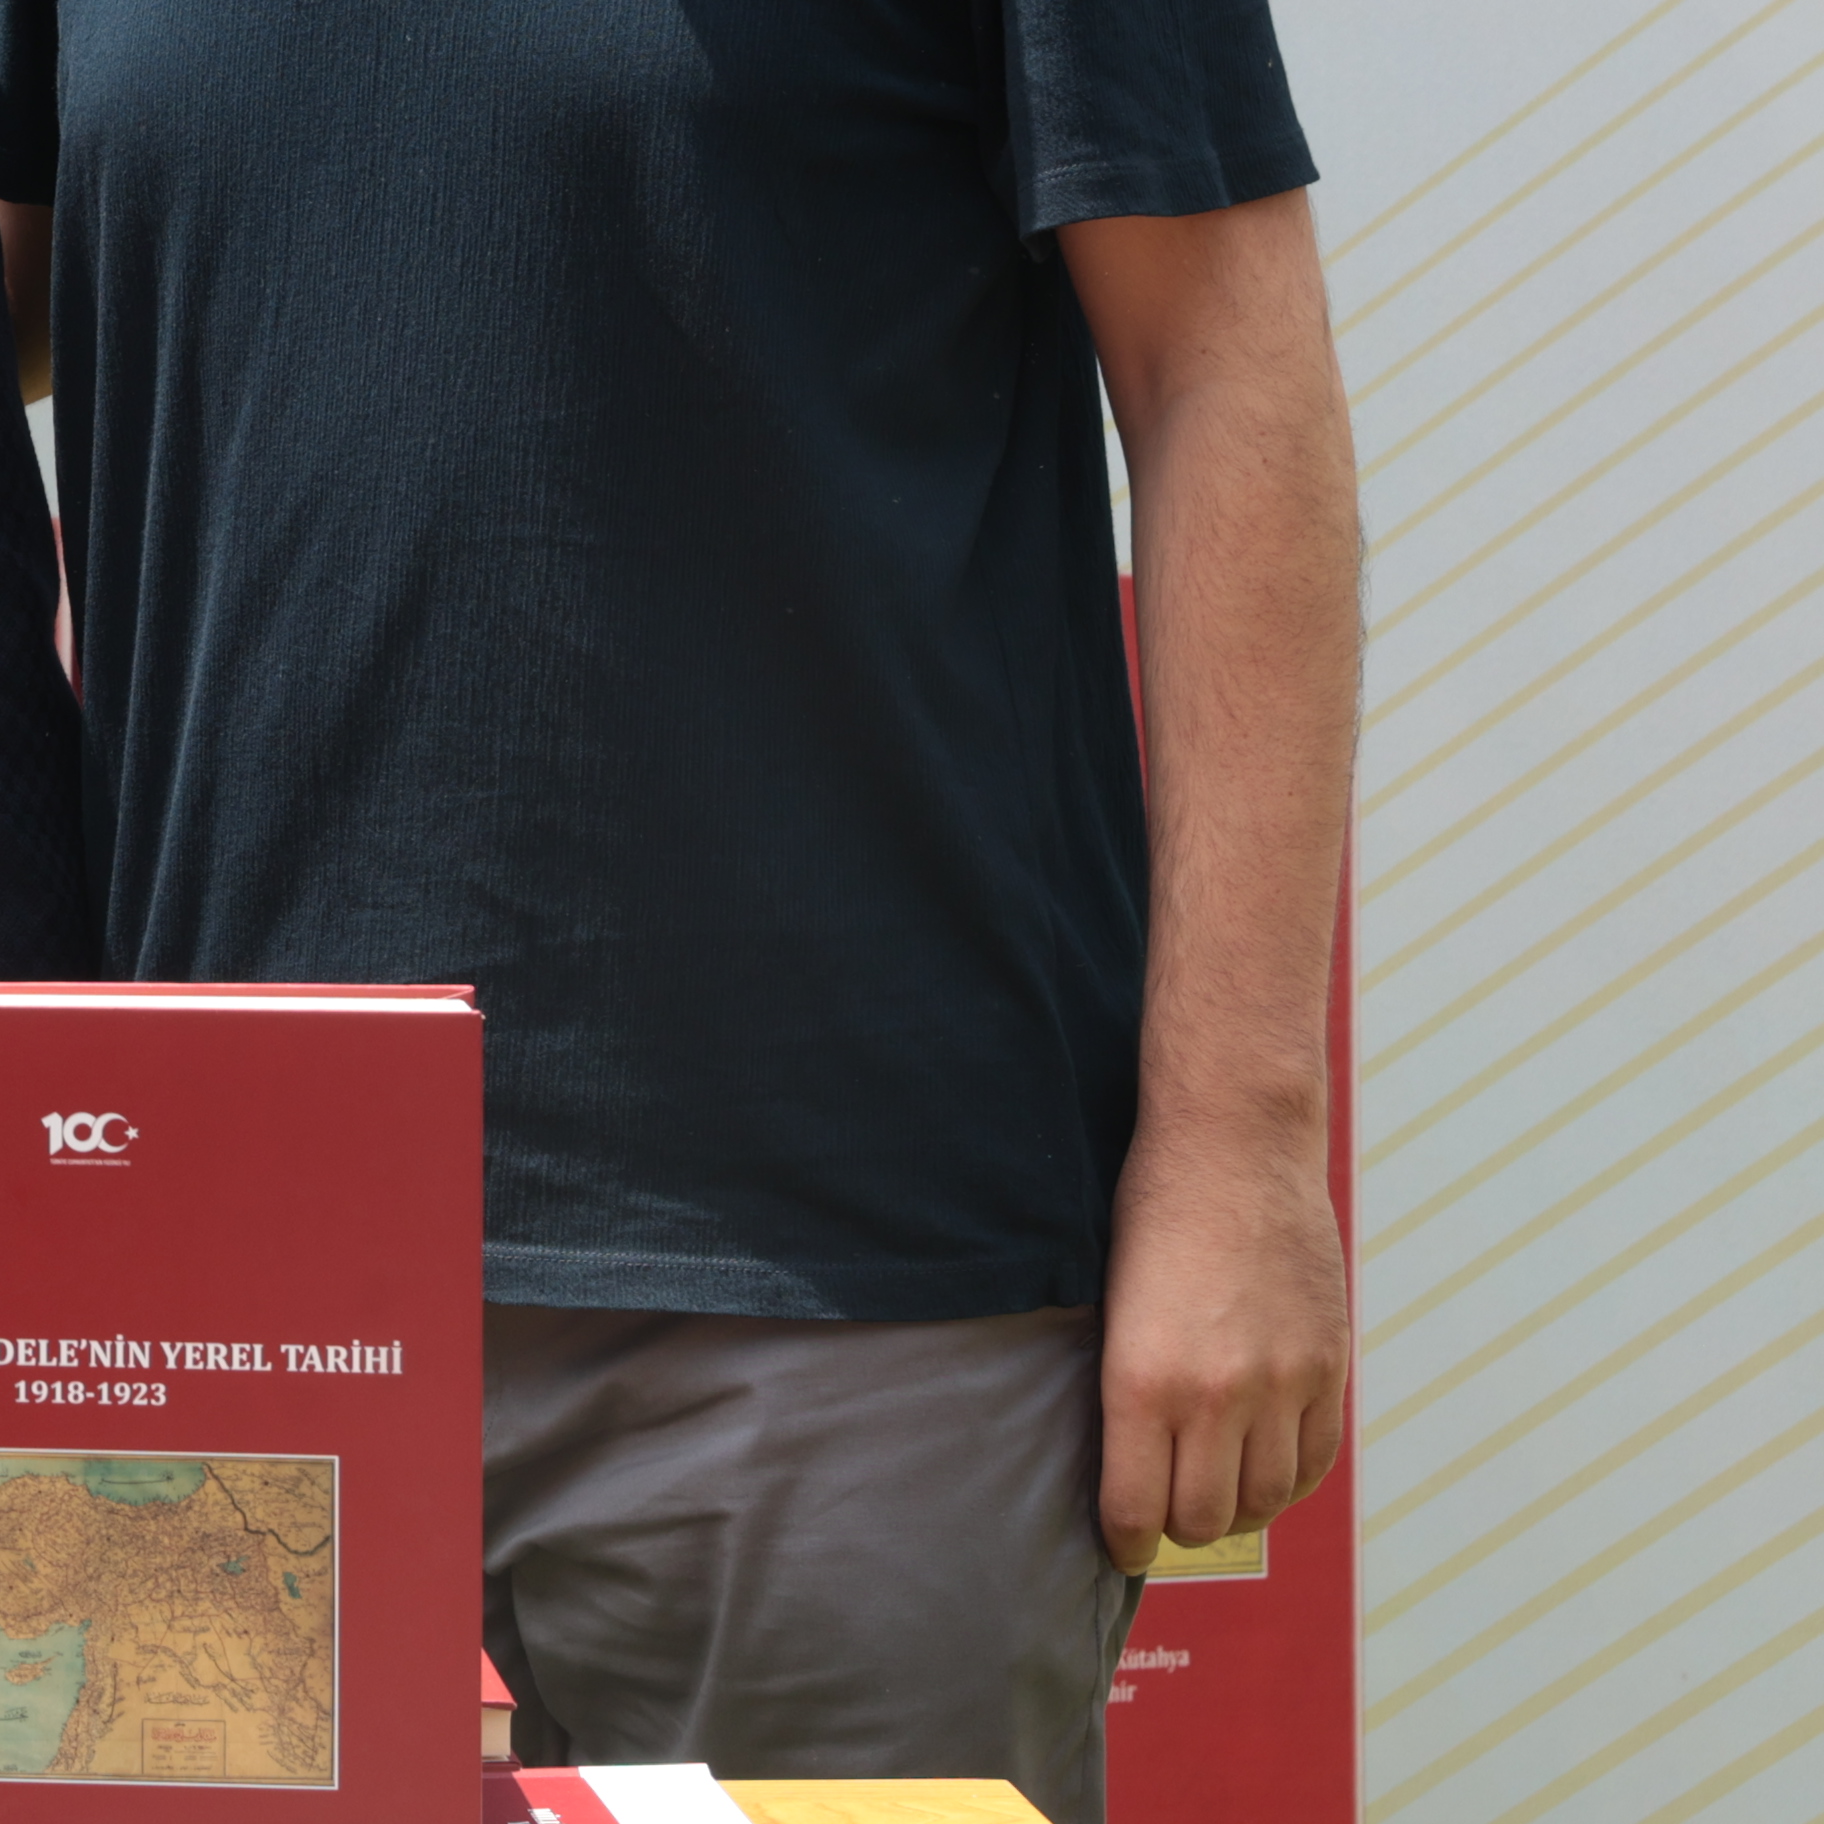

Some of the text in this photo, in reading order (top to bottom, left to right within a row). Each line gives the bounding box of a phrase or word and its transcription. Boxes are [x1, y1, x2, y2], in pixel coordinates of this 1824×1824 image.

[160, 1341, 272, 1372] YEREL
[280, 1339, 402, 1375] TARİHİ
[15, 1380, 167, 1406] 1918-1923
